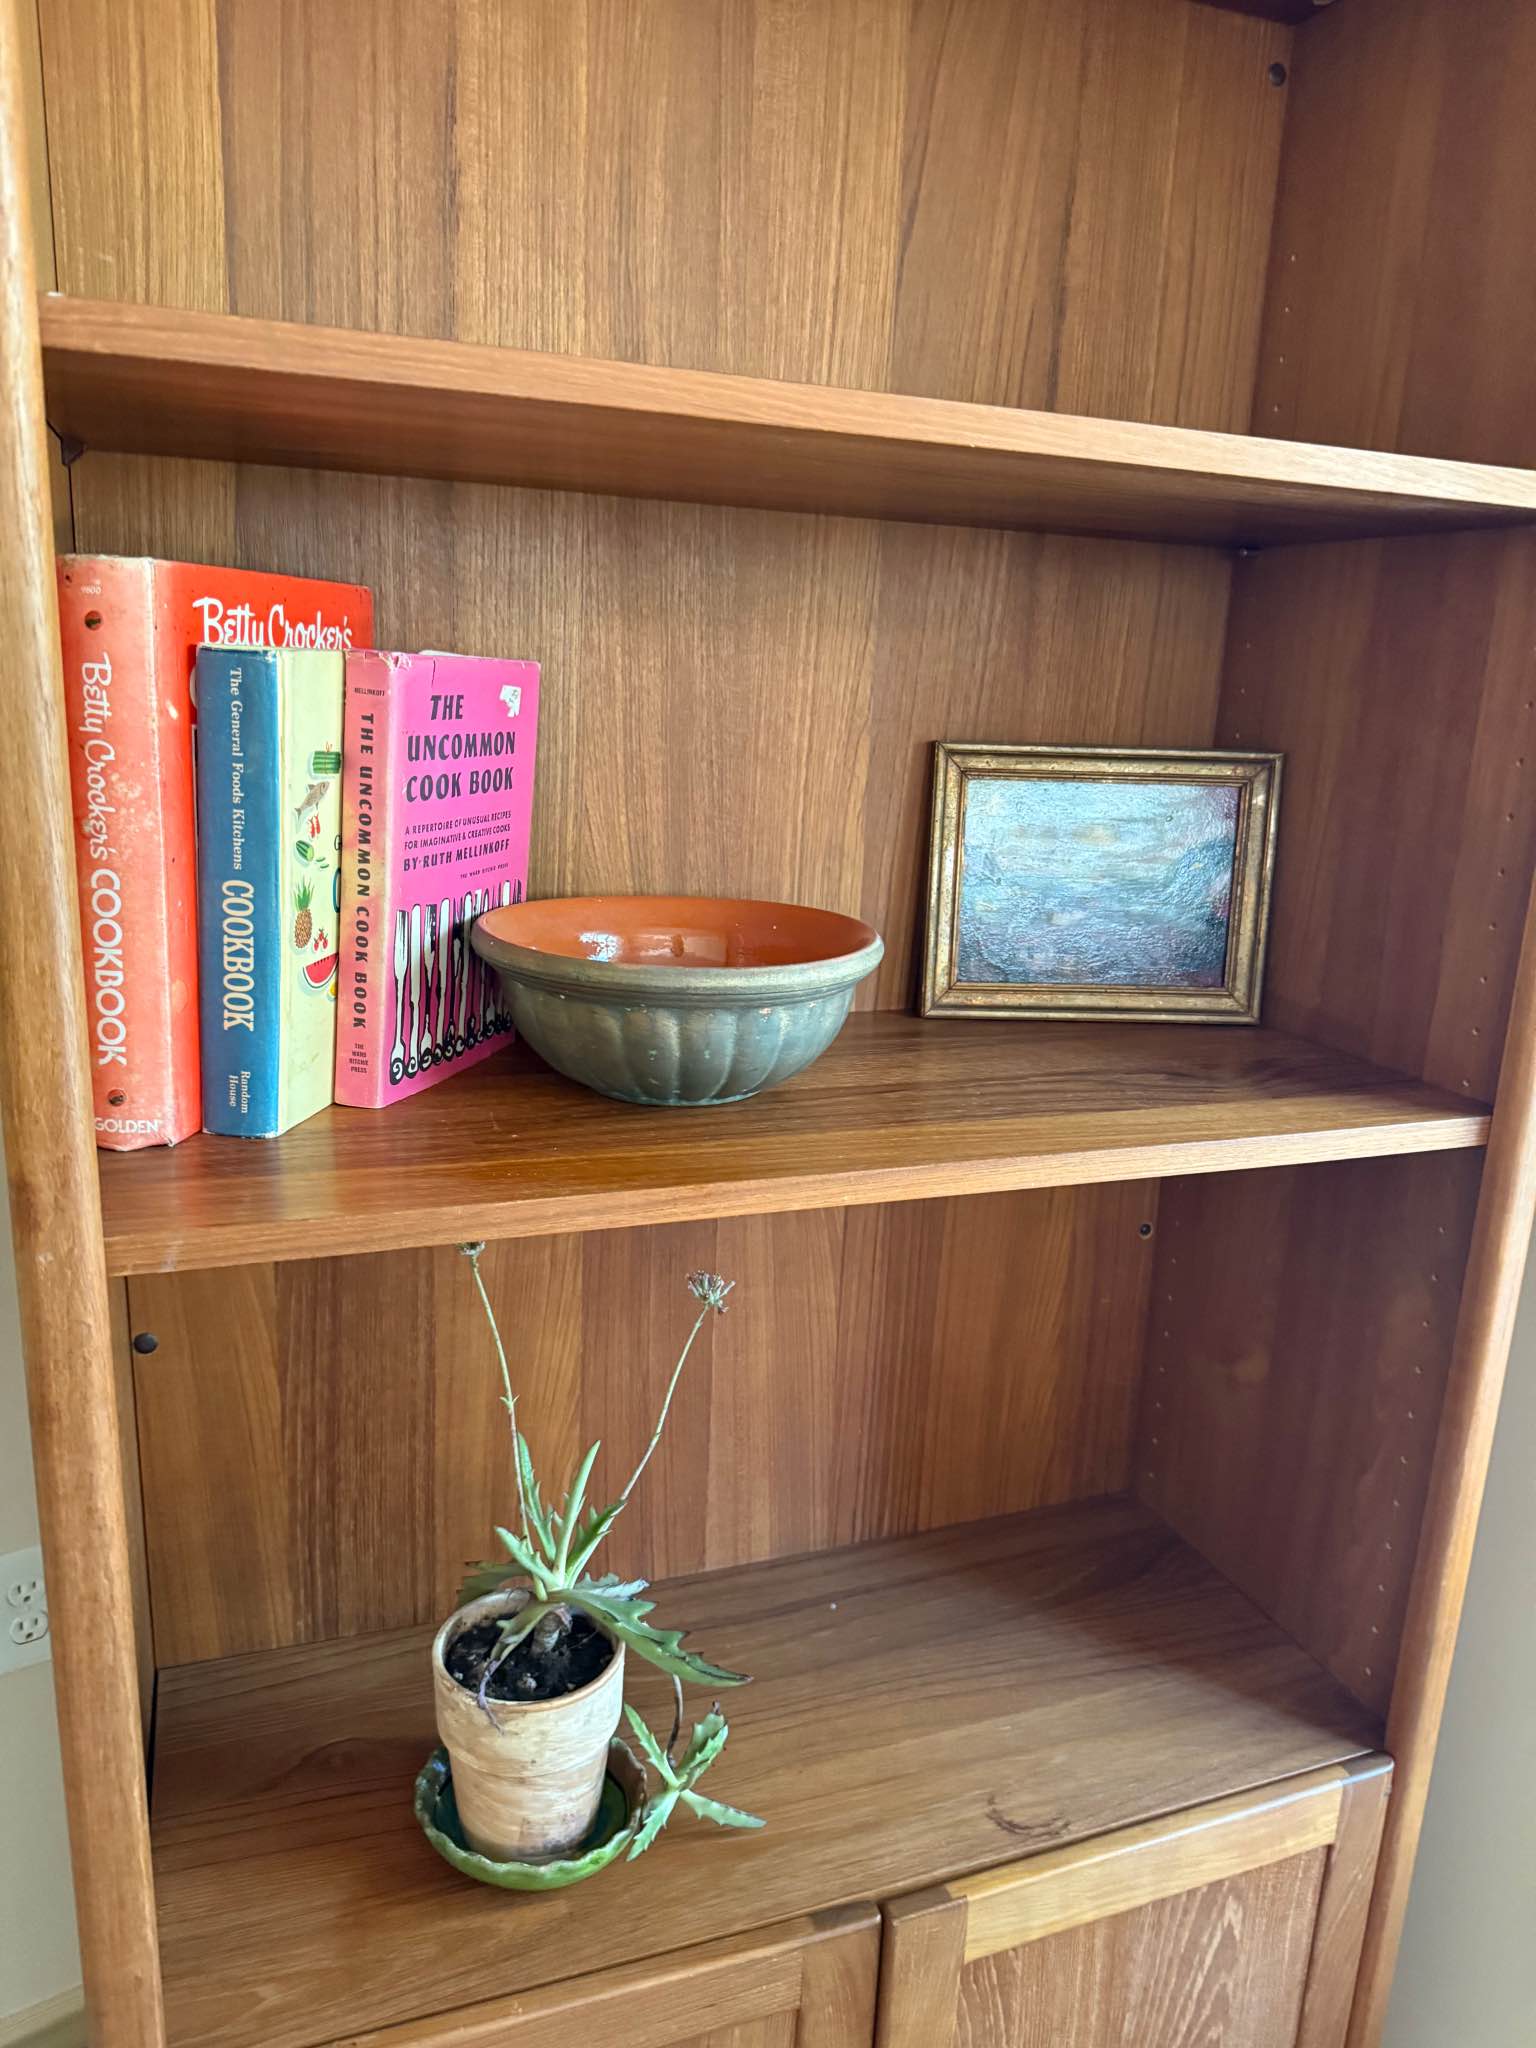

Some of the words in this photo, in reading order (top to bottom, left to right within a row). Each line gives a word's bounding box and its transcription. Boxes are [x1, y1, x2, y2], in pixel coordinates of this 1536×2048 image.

[192, 596, 264, 646] Betty
[268, 603, 353, 650] Crocker's
[79, 652, 113, 733] Betty
[230, 667, 243, 696] The
[230, 700, 244, 757] General
[430, 694, 464, 721] THE
[360, 713, 374, 755] THE
[407, 731, 516, 762] UNCOMMON
[84, 739, 117, 861] Crocker's
[231, 762, 245, 804] Foods
[406, 772, 462, 803] COOK
[469, 766, 514, 796] BOOK
[232, 808, 246, 871] Kitchens
[358, 766, 373, 897] UNCOMMON
[404, 825, 410, 836] A
[412, 820, 453, 835] REPERTOIRE
[454, 817, 462, 828] OF
[462, 814, 490, 826] UNUSUAL
[490, 810, 511, 821] RECIPES
[404, 841, 418, 850] FOR
[420, 833, 461, 848] IMAGINATIVE
[467, 827, 492, 839] CREATIVE
[492, 823, 511, 834] COOKS
[403, 856, 419, 872] BY
[422, 850, 452, 869] RUTH
[455, 838, 510, 862] MELLINKOFF
[221, 879, 255, 1032] COOKBOOK
[355, 906, 370, 963] COOK
[91, 869, 127, 1065] COOKBOOK
[352, 972, 368, 1029] BOOK
[229, 1074, 239, 1107] House
[350, 1066, 368, 1074] PRESS
[240, 1071, 252, 1114] Random
[95, 1117, 159, 1134] GOLDEN
